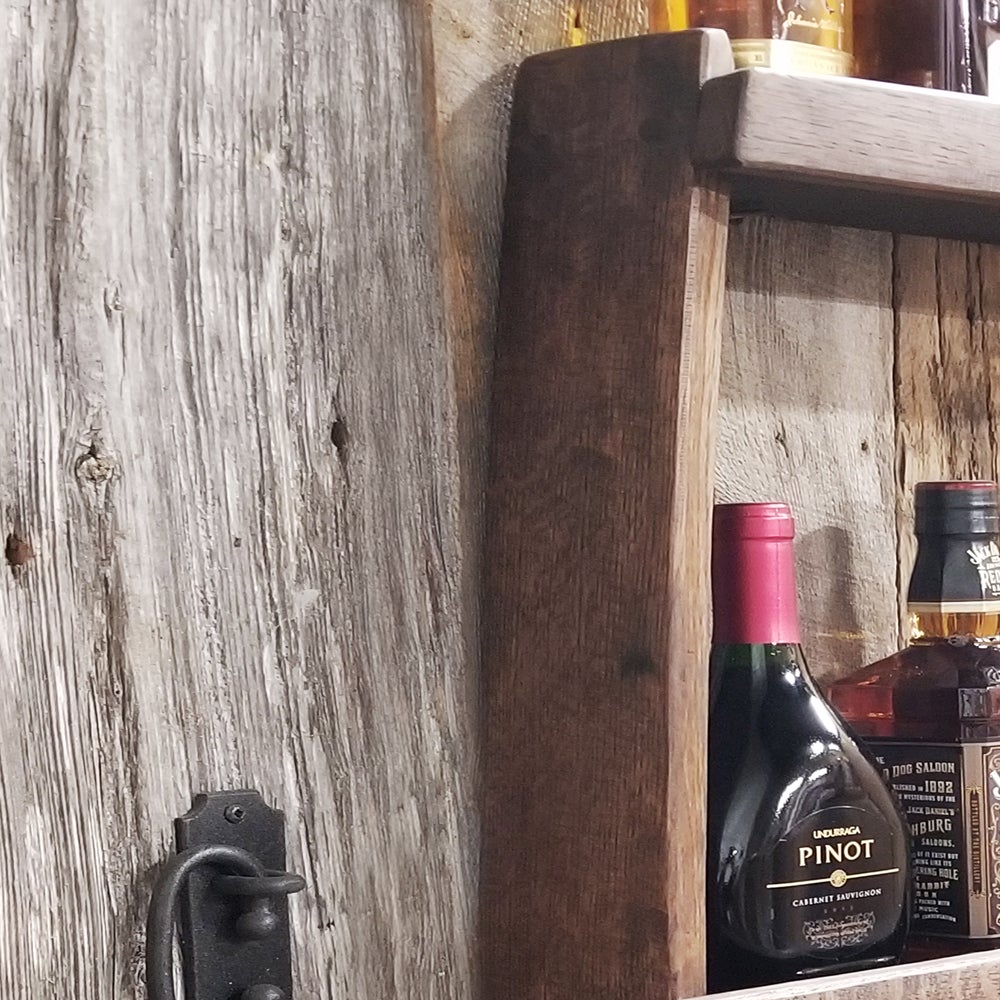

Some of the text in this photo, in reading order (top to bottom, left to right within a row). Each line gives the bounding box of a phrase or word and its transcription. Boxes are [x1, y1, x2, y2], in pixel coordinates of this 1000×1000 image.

[892, 761, 955, 778] DOG SALOON
[813, 825, 862, 840] UNDURRAGA
[798, 838, 875, 867] PINOT
[792, 887, 882, 908] CABERNET SAUVIGNON
